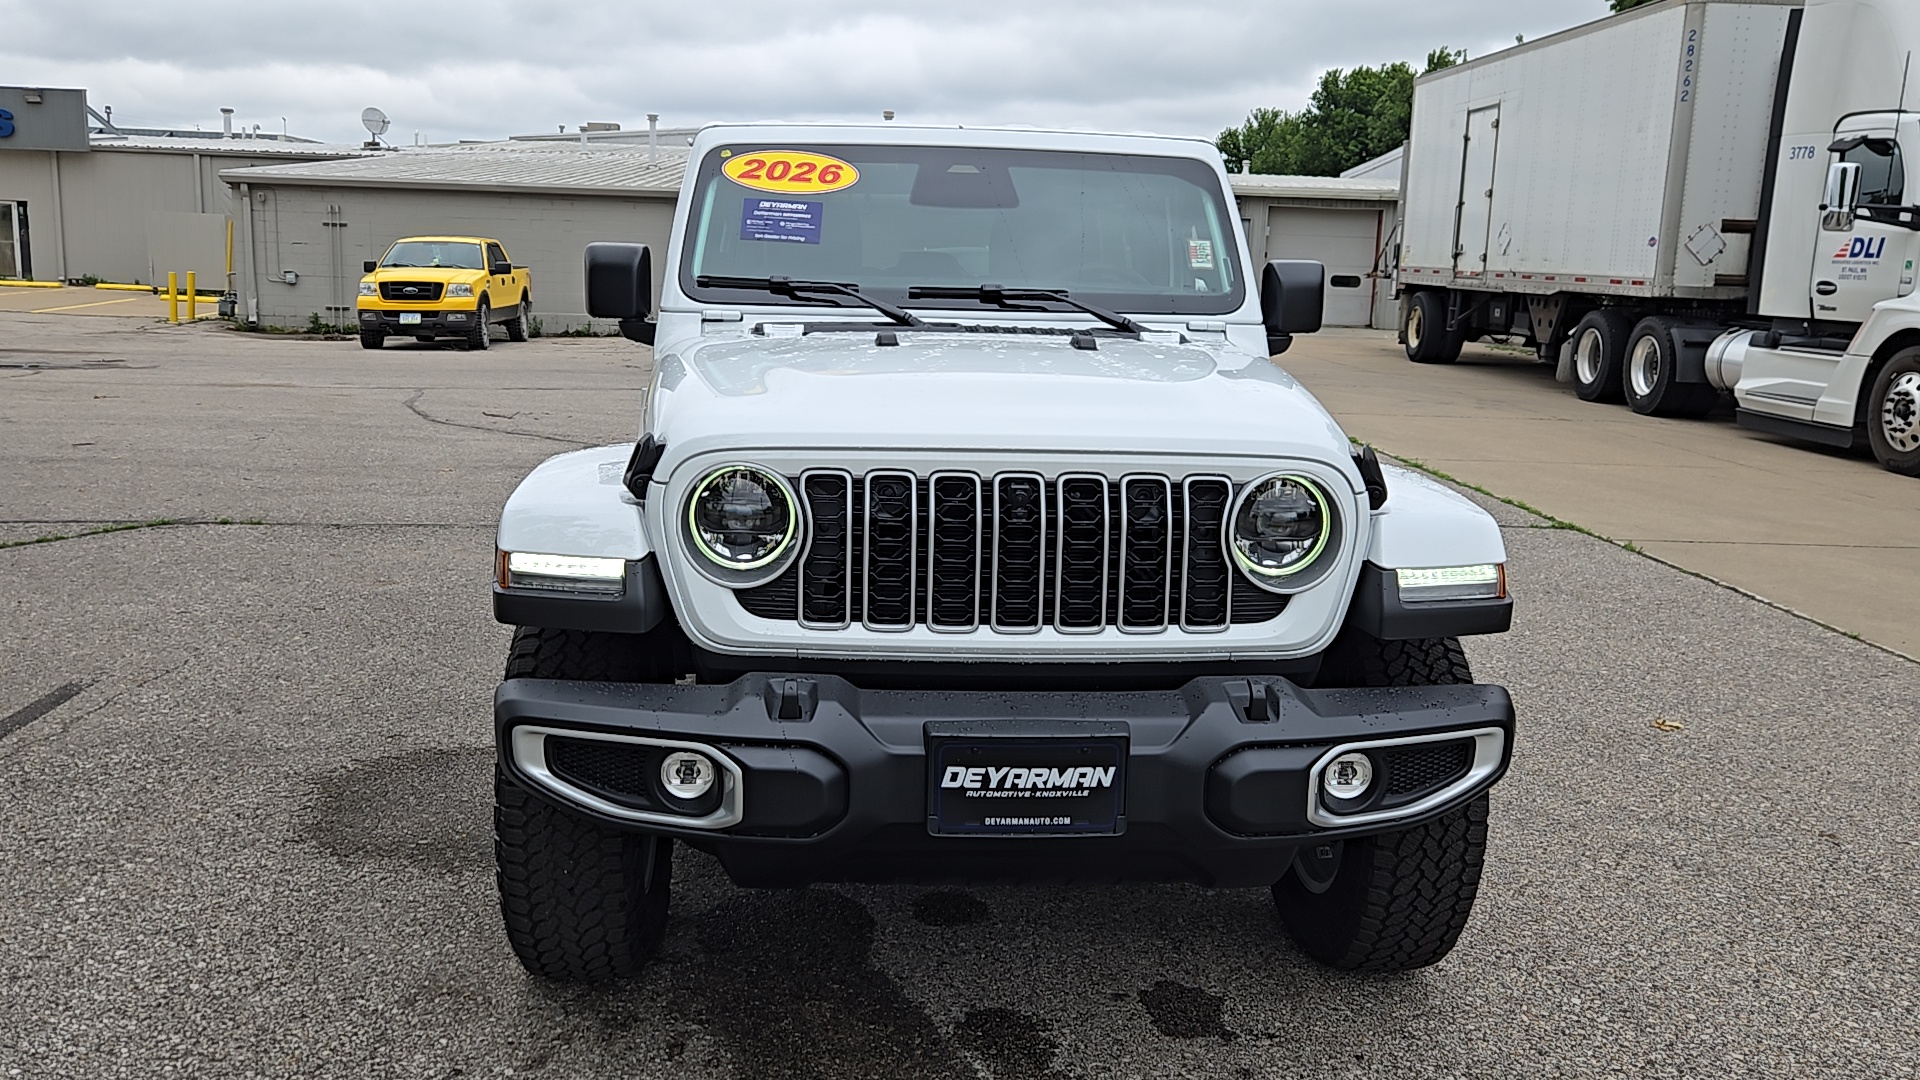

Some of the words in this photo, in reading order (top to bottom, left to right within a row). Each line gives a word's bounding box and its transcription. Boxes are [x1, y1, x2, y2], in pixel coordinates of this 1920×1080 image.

[1680, 29, 1697, 102] 28262
[1789, 145, 1816, 160] 3778
[737, 158, 844, 185] 2026
[759, 201, 807, 210] DEYARMAN
[1848, 236, 1886, 259] DLI
[941, 766, 1116, 789] DEYARMAN
[984, 817, 1071, 826] DEYARMANAUTO.COM
